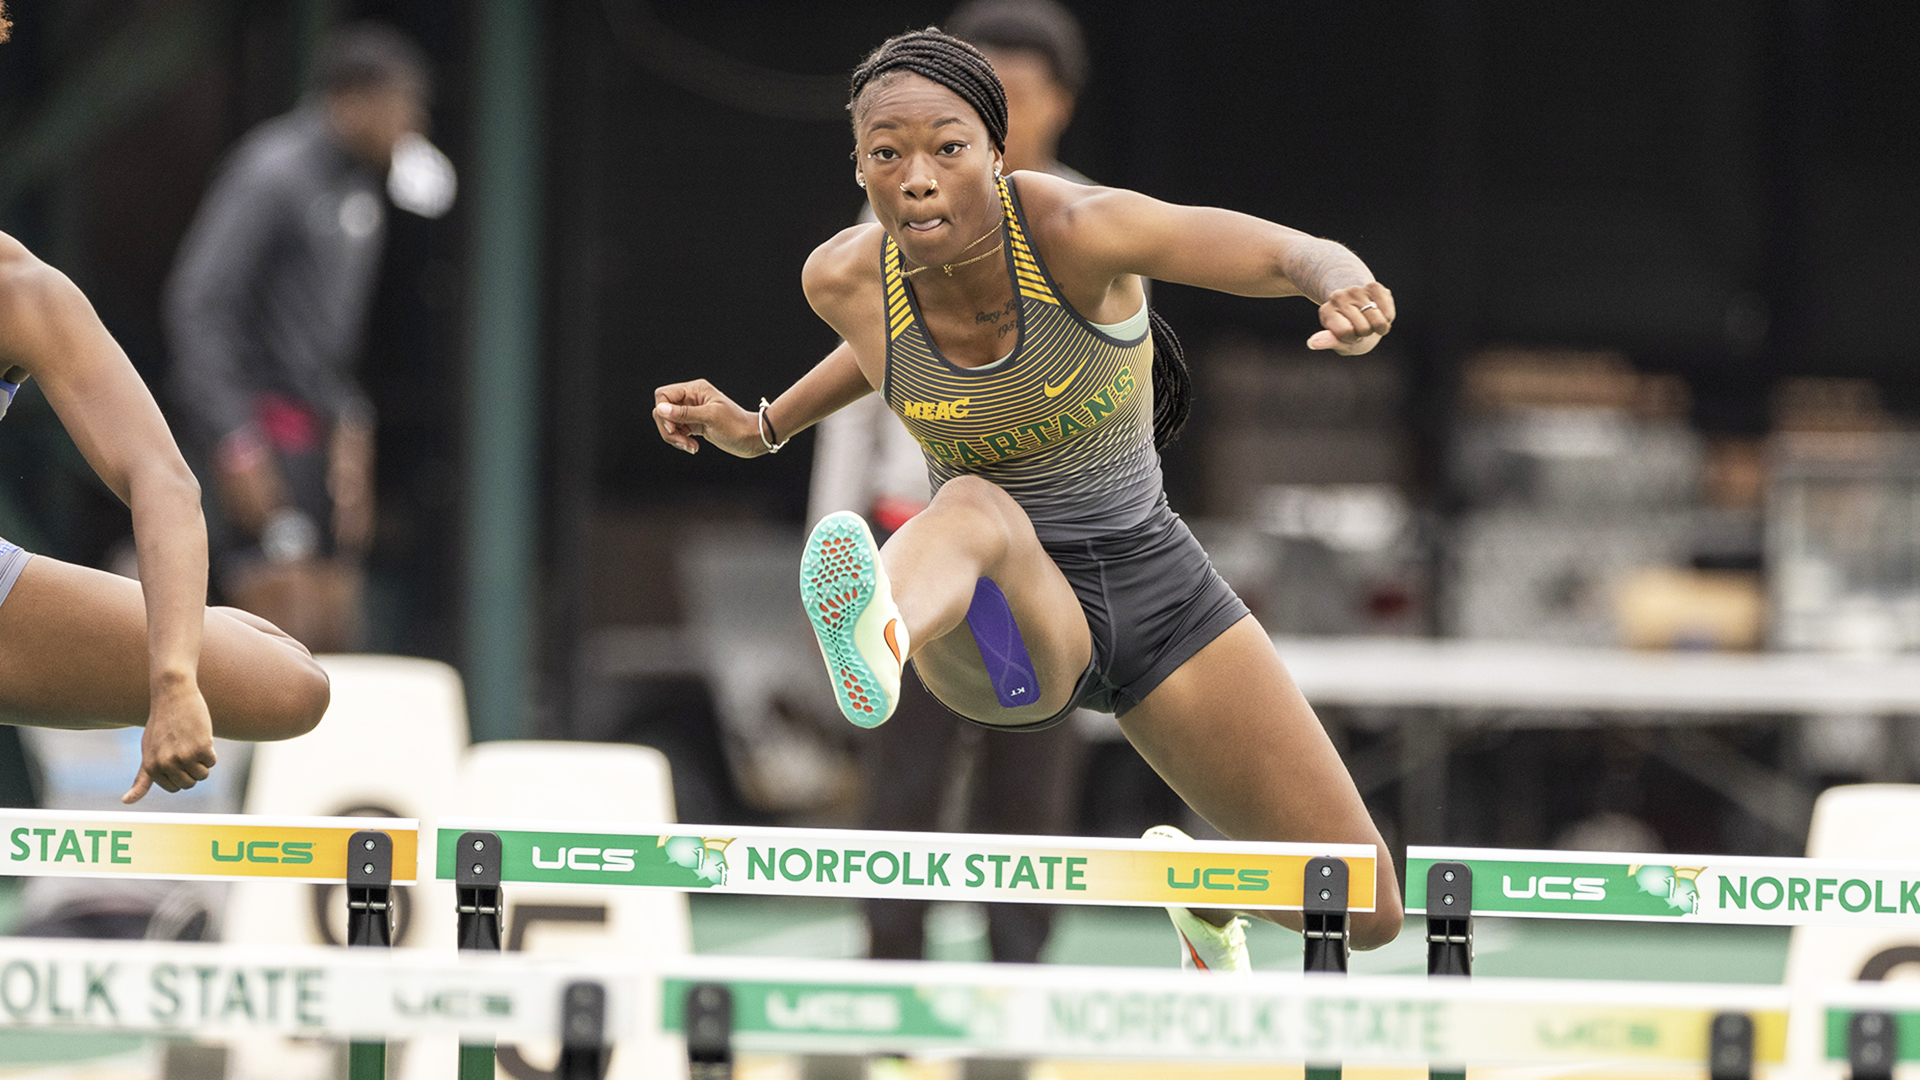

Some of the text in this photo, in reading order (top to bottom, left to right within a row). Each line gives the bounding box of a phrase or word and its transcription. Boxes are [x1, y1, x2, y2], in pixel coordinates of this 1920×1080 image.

[904, 398, 970, 421] MEAC
[914, 365, 1136, 467] PARTANS
[10, 827, 315, 865] STATE UCS
[532, 846, 1271, 892] UCS NORFOLK STATE UCS
[1502, 875, 1607, 901] UCS
[149, 963, 325, 1028] STATE
